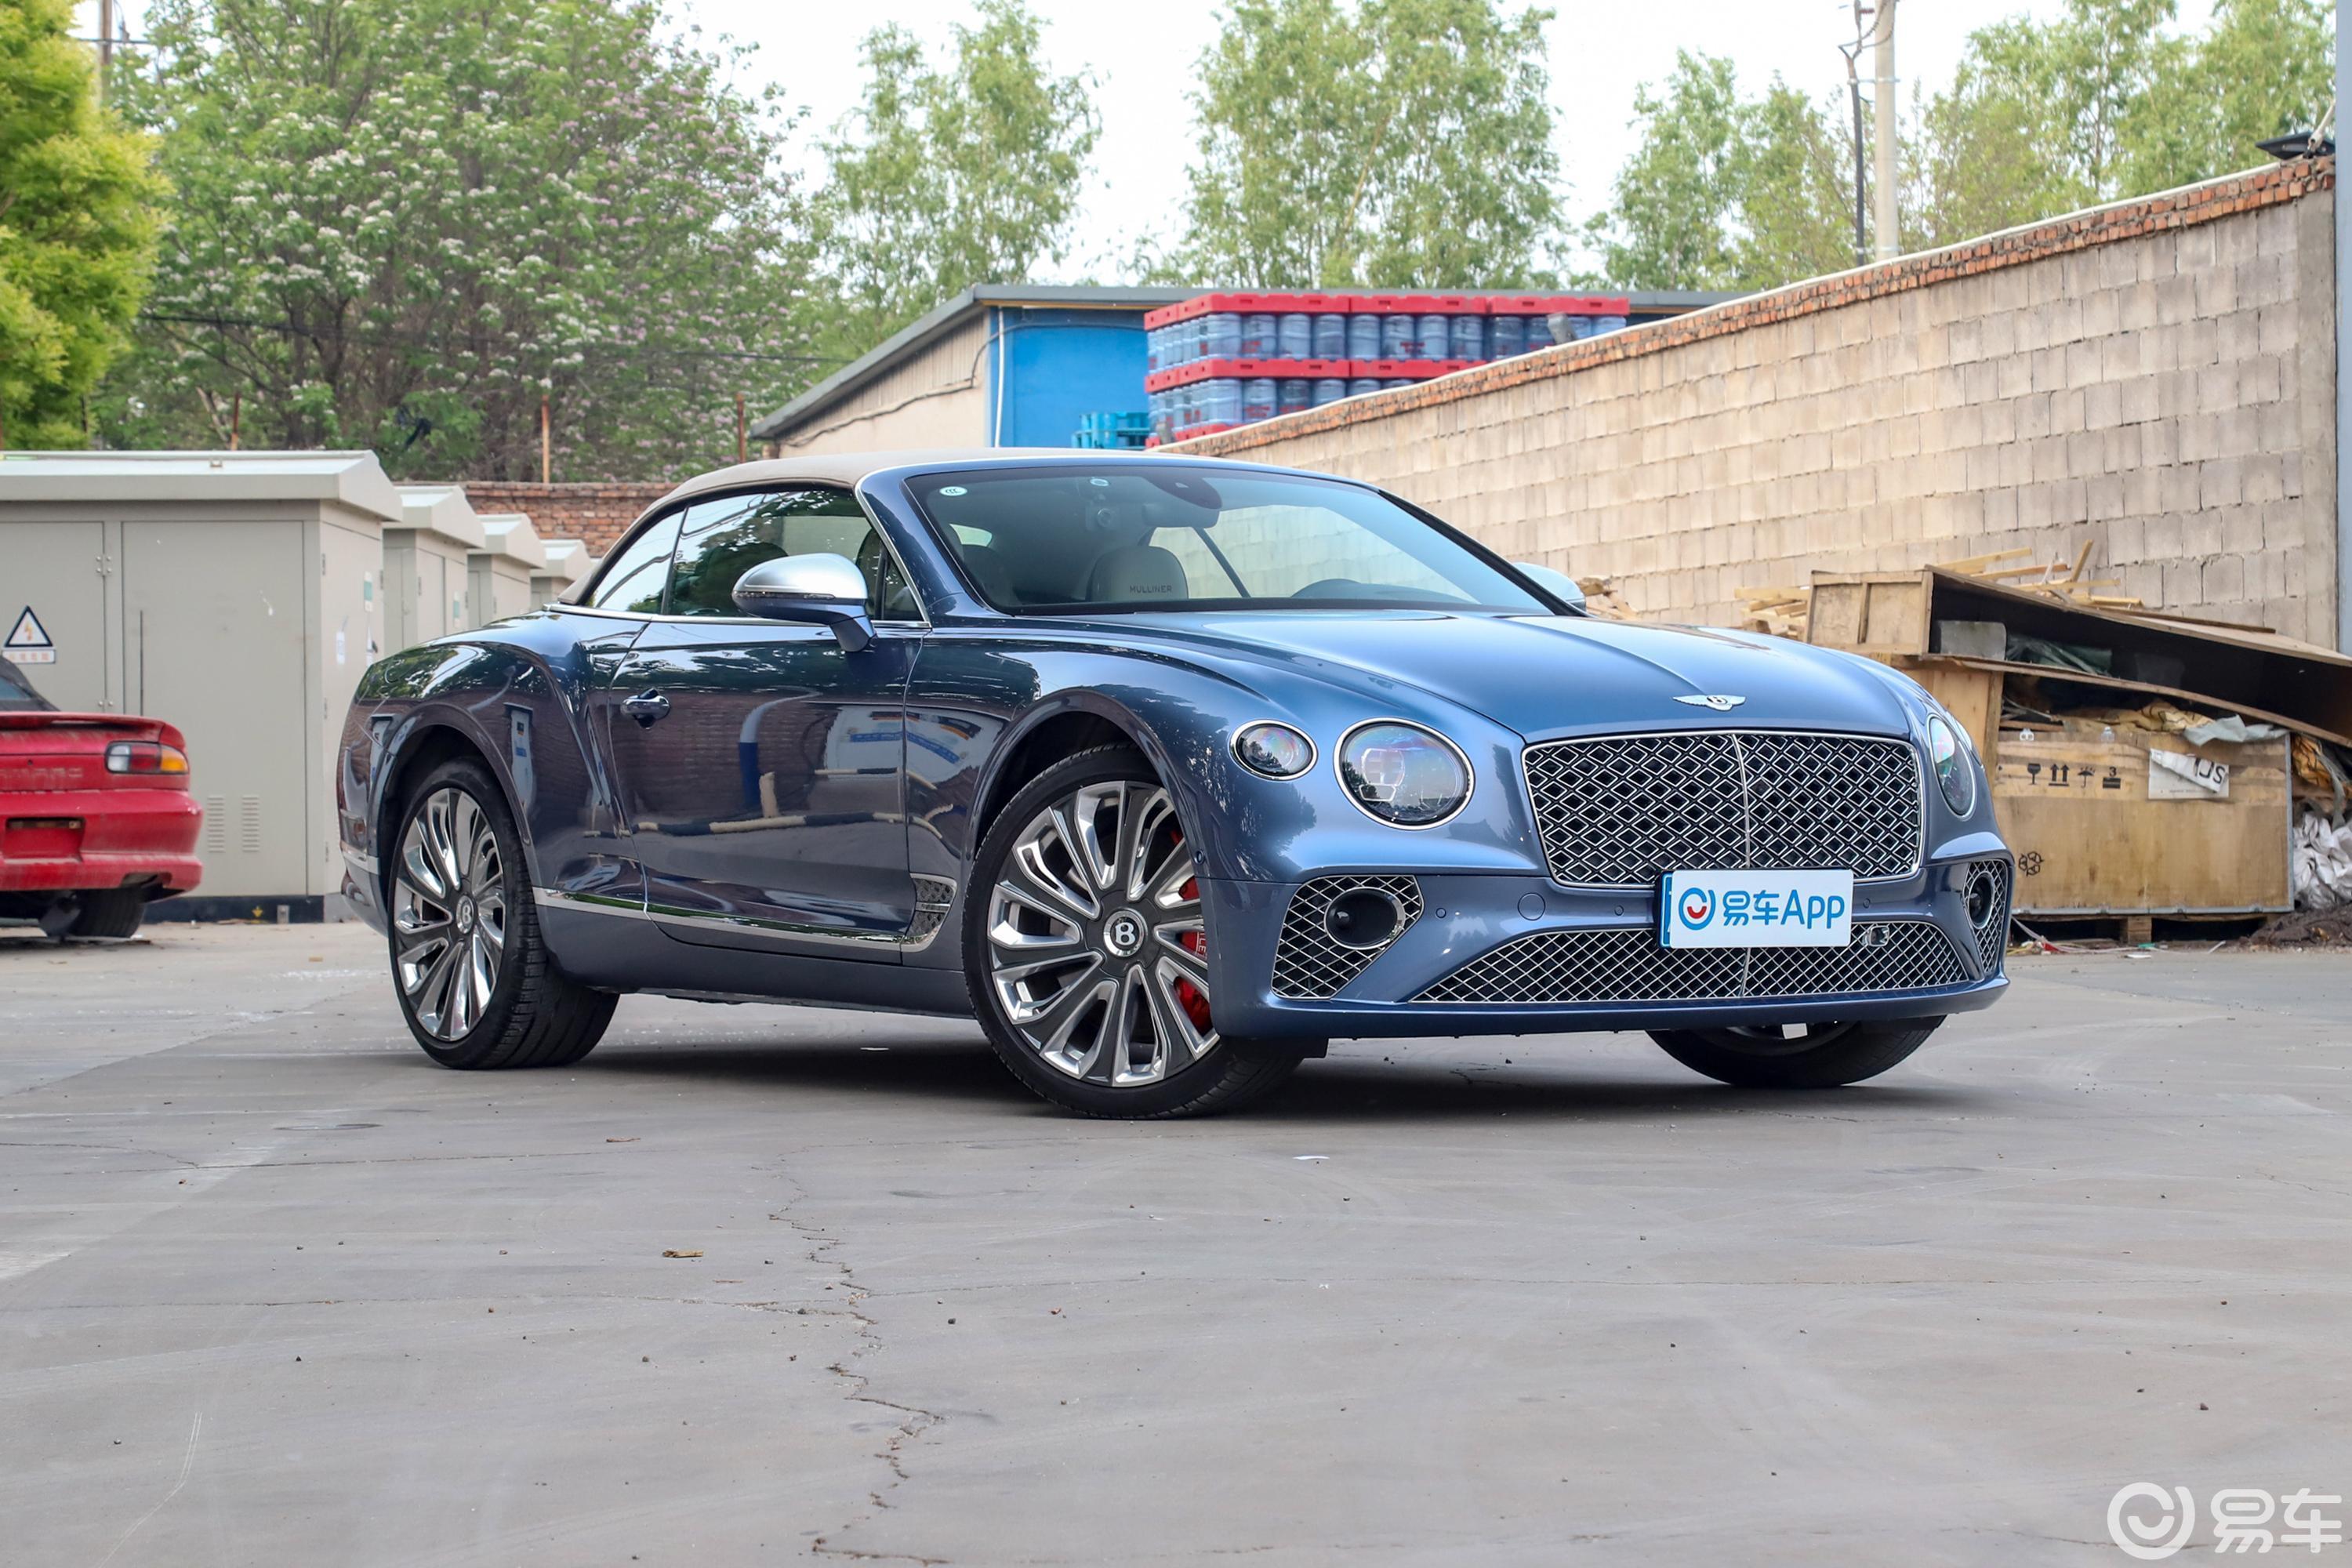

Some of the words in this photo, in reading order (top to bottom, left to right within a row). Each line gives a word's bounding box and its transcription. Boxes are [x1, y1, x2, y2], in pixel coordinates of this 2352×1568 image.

[1129, 584, 1172, 593] MULLINER
[2109, 766, 2117, 777] 3
[1722, 889, 1846, 930] 易车App
[1115, 921, 1136, 946] B
